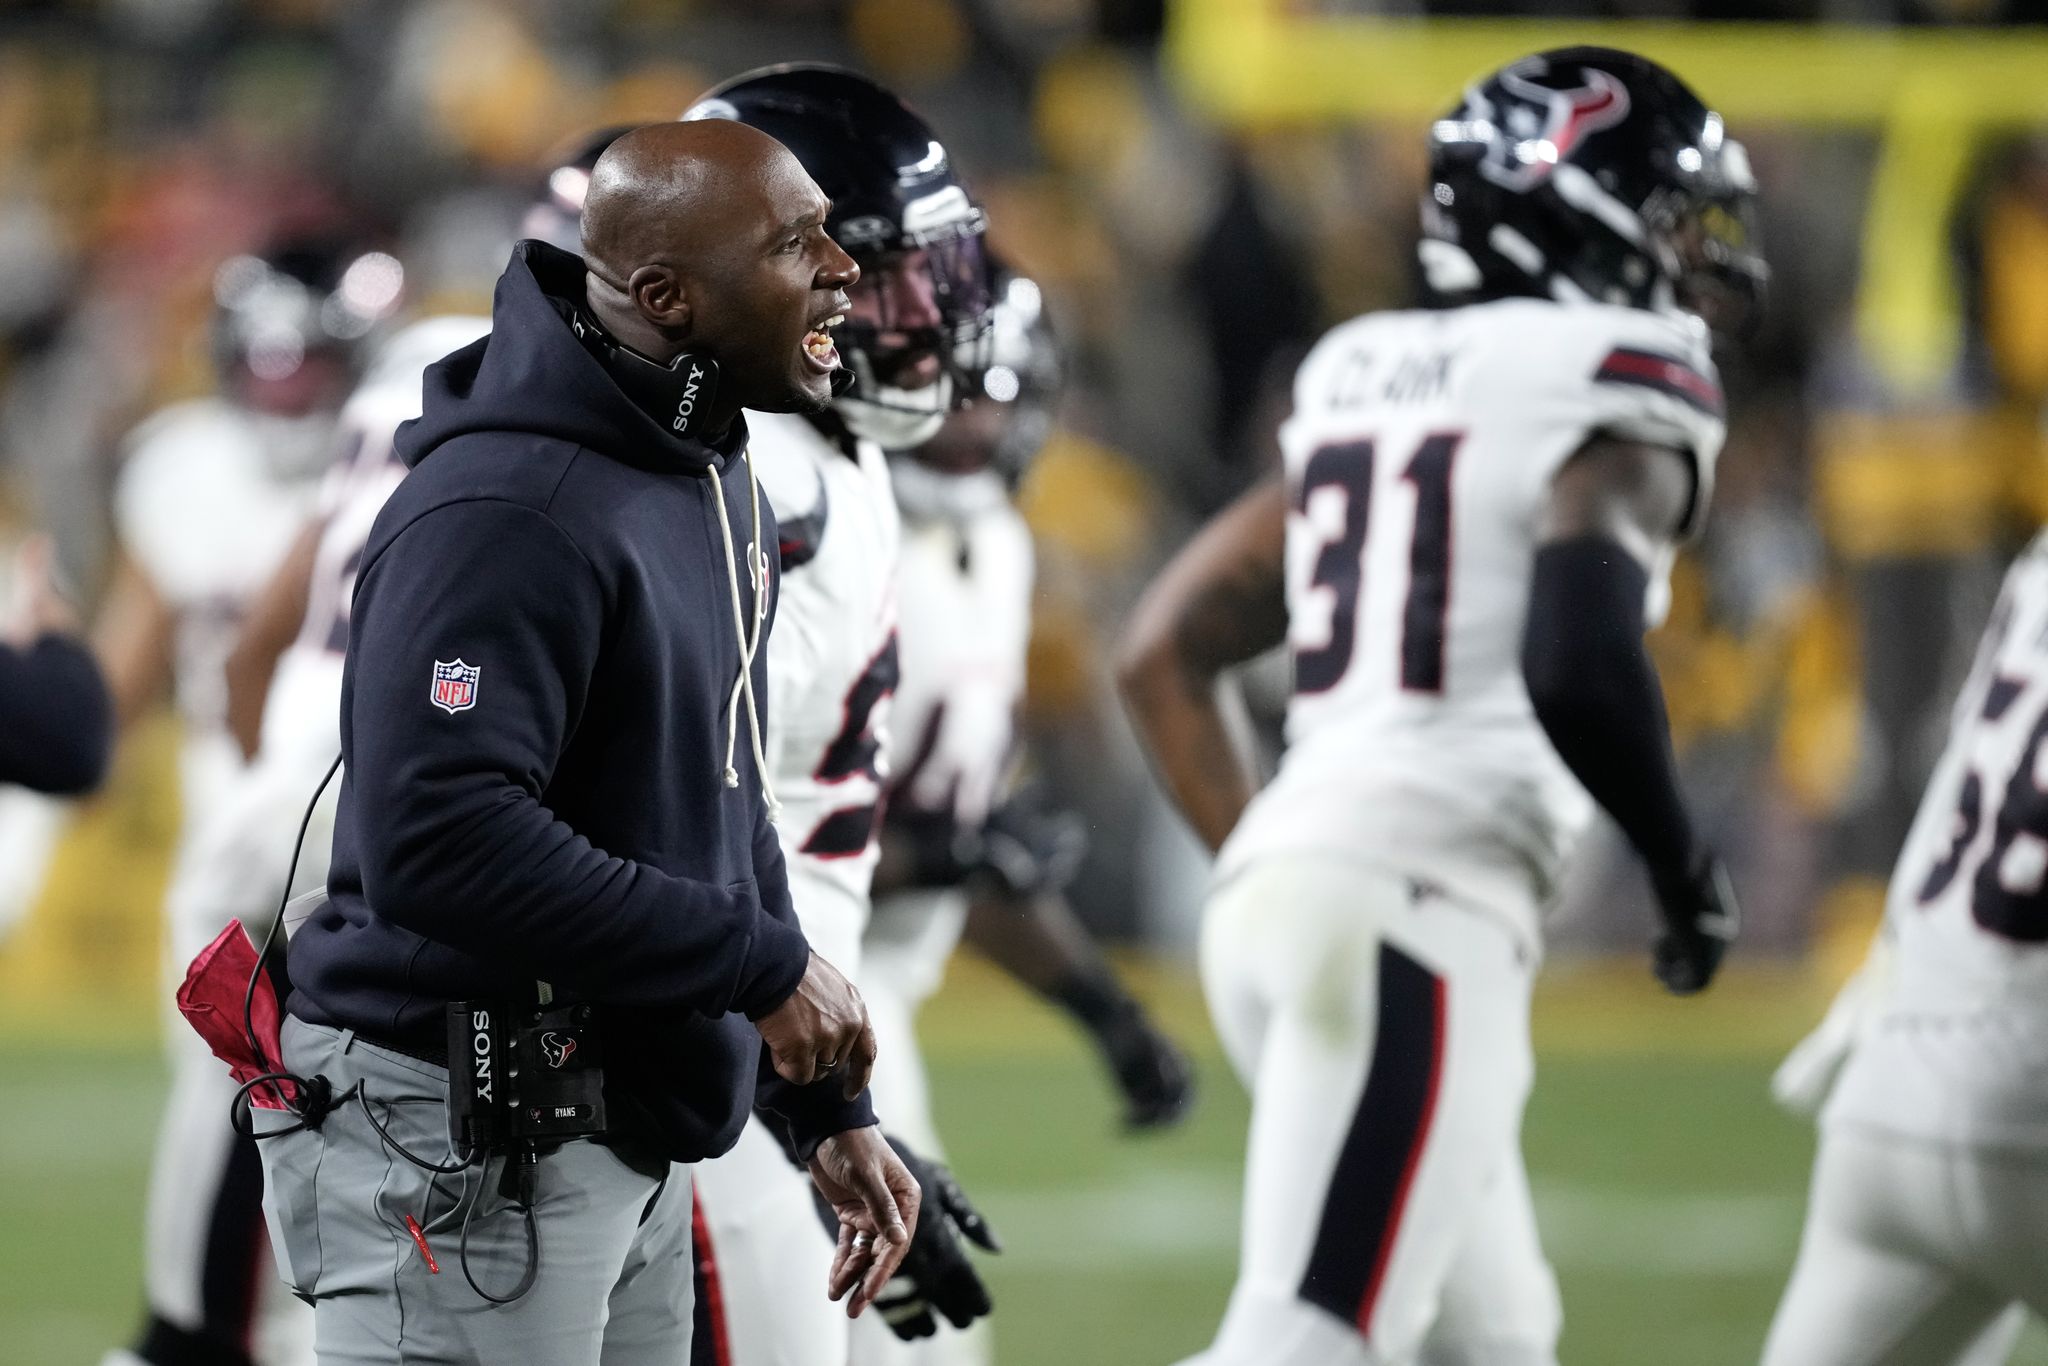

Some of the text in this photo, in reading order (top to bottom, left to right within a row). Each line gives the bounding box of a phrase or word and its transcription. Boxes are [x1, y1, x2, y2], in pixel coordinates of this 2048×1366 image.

[673, 363, 704, 432] SONY
[1292, 428, 1466, 696] 31
[437, 680, 470, 705] NFL
[473, 1010, 493, 1104] SONY
[555, 1106, 576, 1118] RYANS
